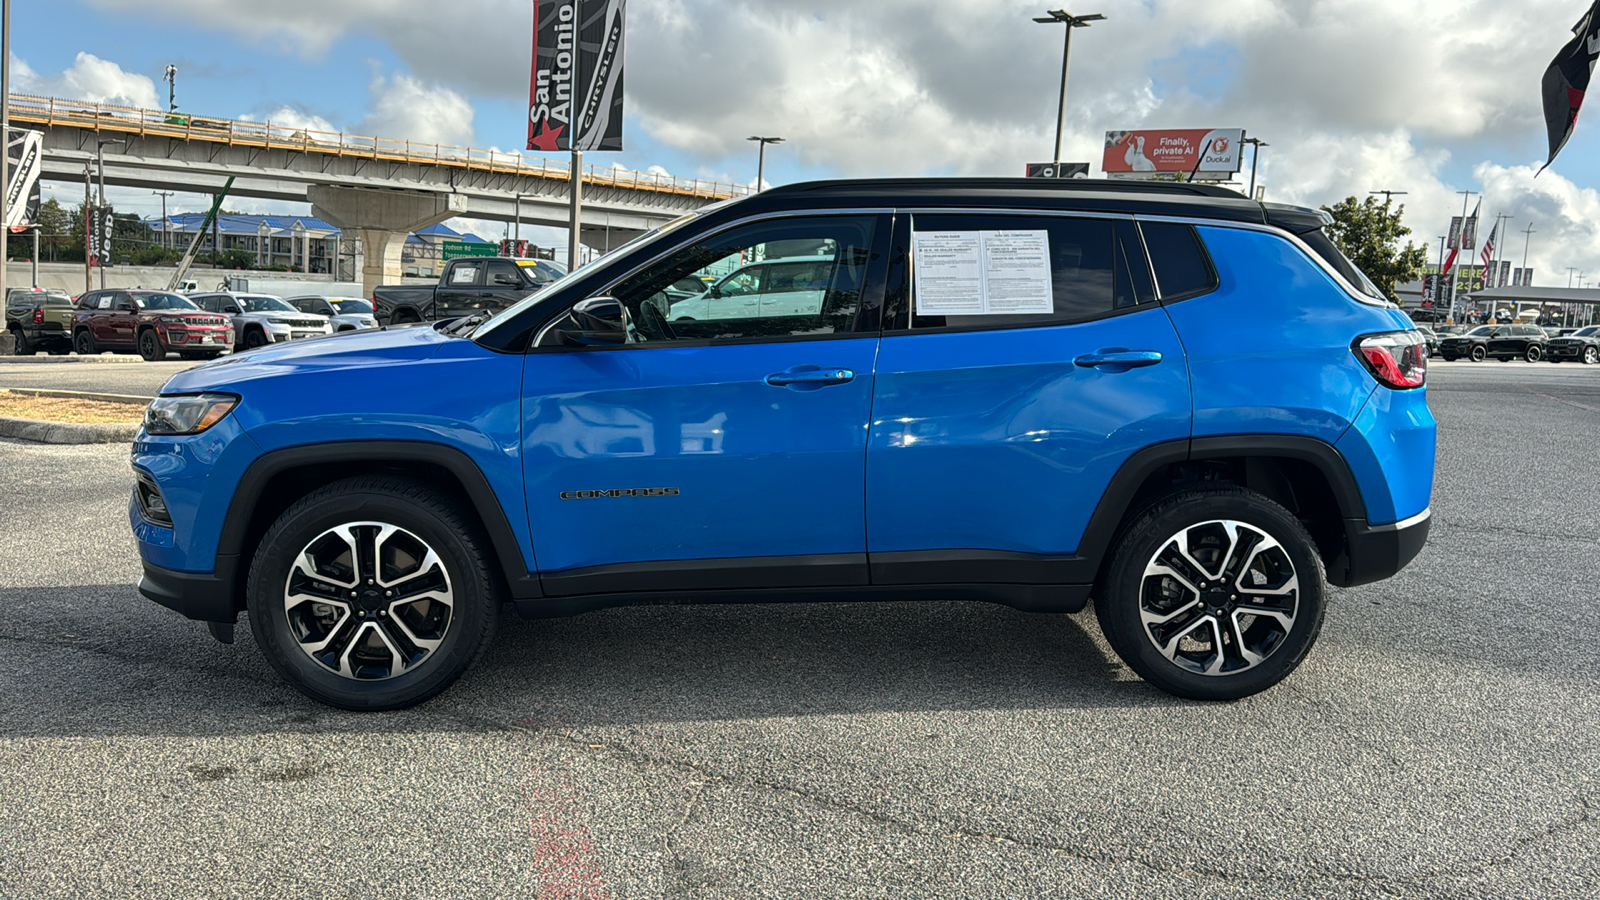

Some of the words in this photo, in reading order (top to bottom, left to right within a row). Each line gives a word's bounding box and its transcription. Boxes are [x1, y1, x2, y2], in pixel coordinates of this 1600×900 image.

[551, 4, 573, 124] Antonio
[584, 26, 620, 129] CHRYSLER
[530, 69, 550, 123] San
[1153, 146, 1183, 156] private
[1184, 146, 1194, 155] AI
[1160, 137, 1189, 147] Finally,
[101, 214, 114, 262] Jeep
[1429, 275, 1438, 302] Antonio
[559, 486, 680, 500] COMPASS
